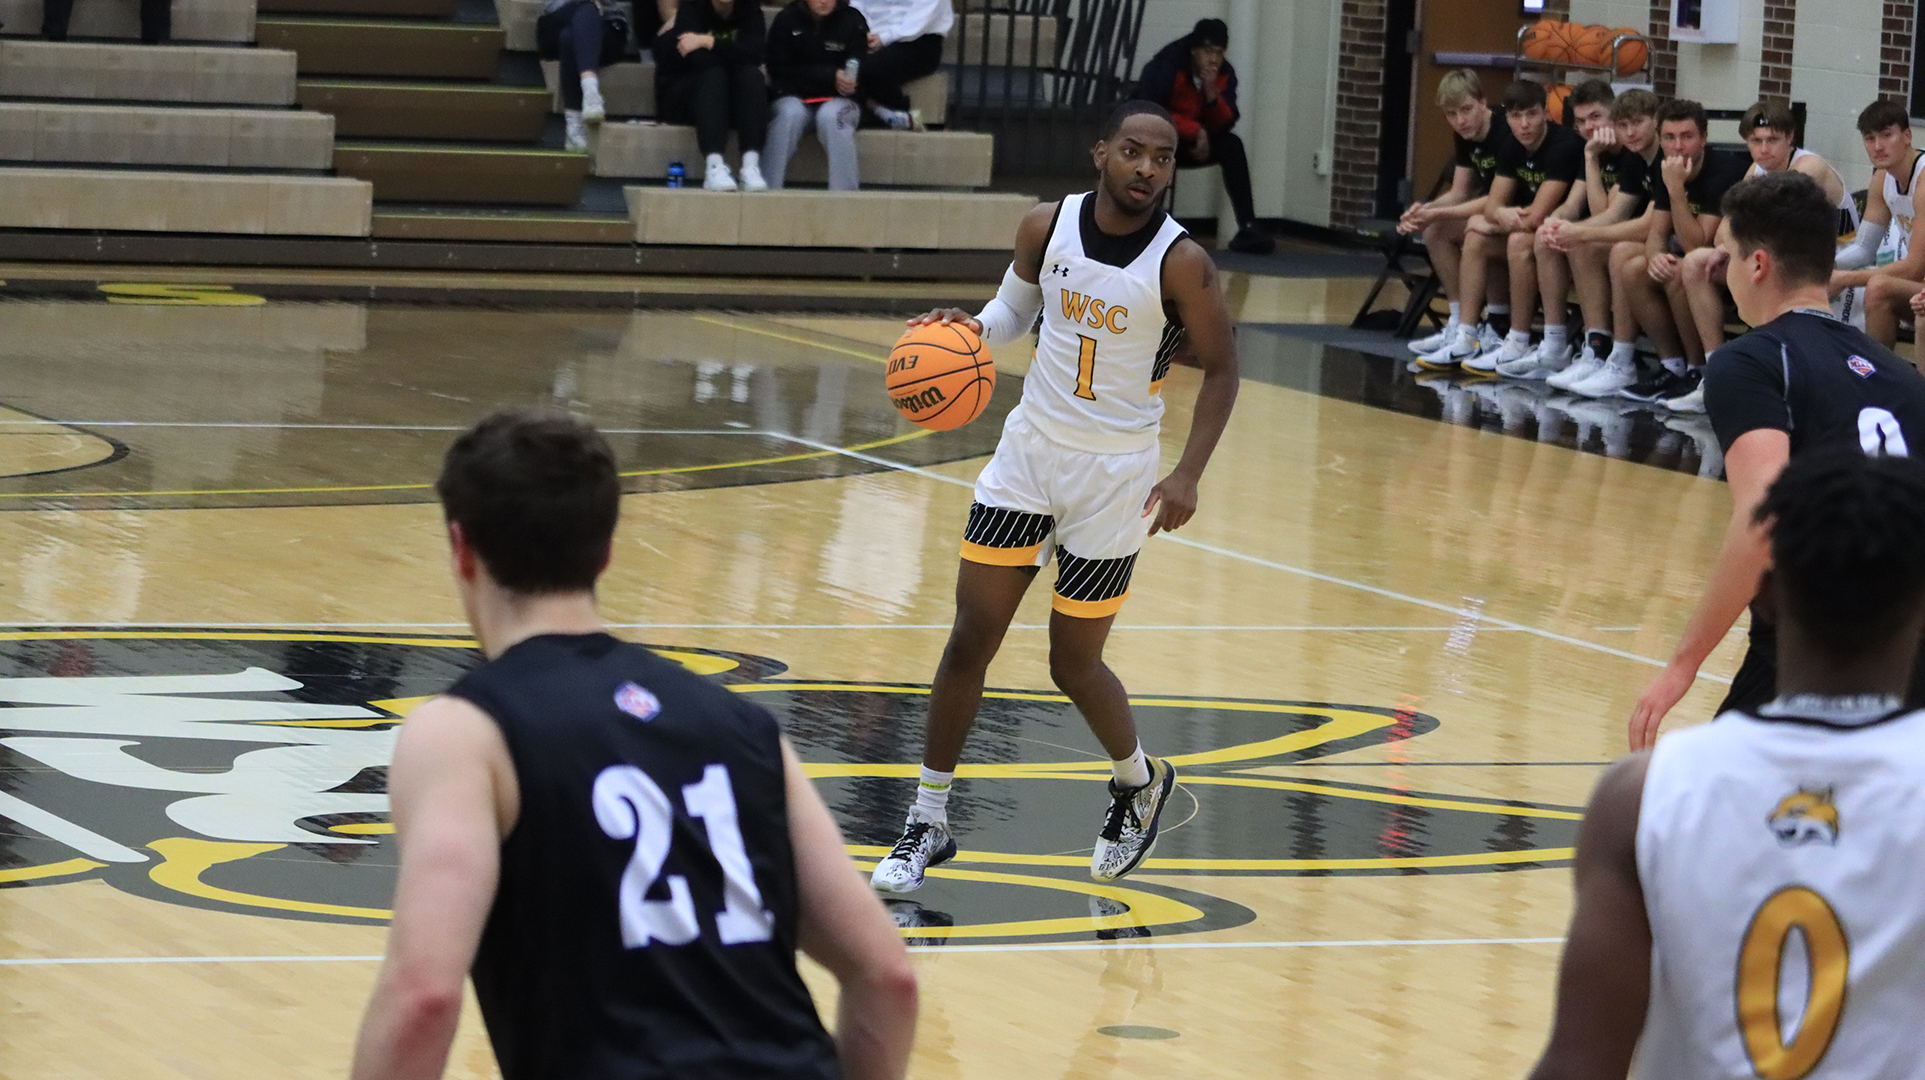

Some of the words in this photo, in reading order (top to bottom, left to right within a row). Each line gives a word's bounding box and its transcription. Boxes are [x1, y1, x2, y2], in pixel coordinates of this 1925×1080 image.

[1061, 288, 1128, 334] WSC
[1073, 333, 1097, 401] 1
[592, 763, 775, 949] 21
[1734, 884, 1849, 1080] 0
